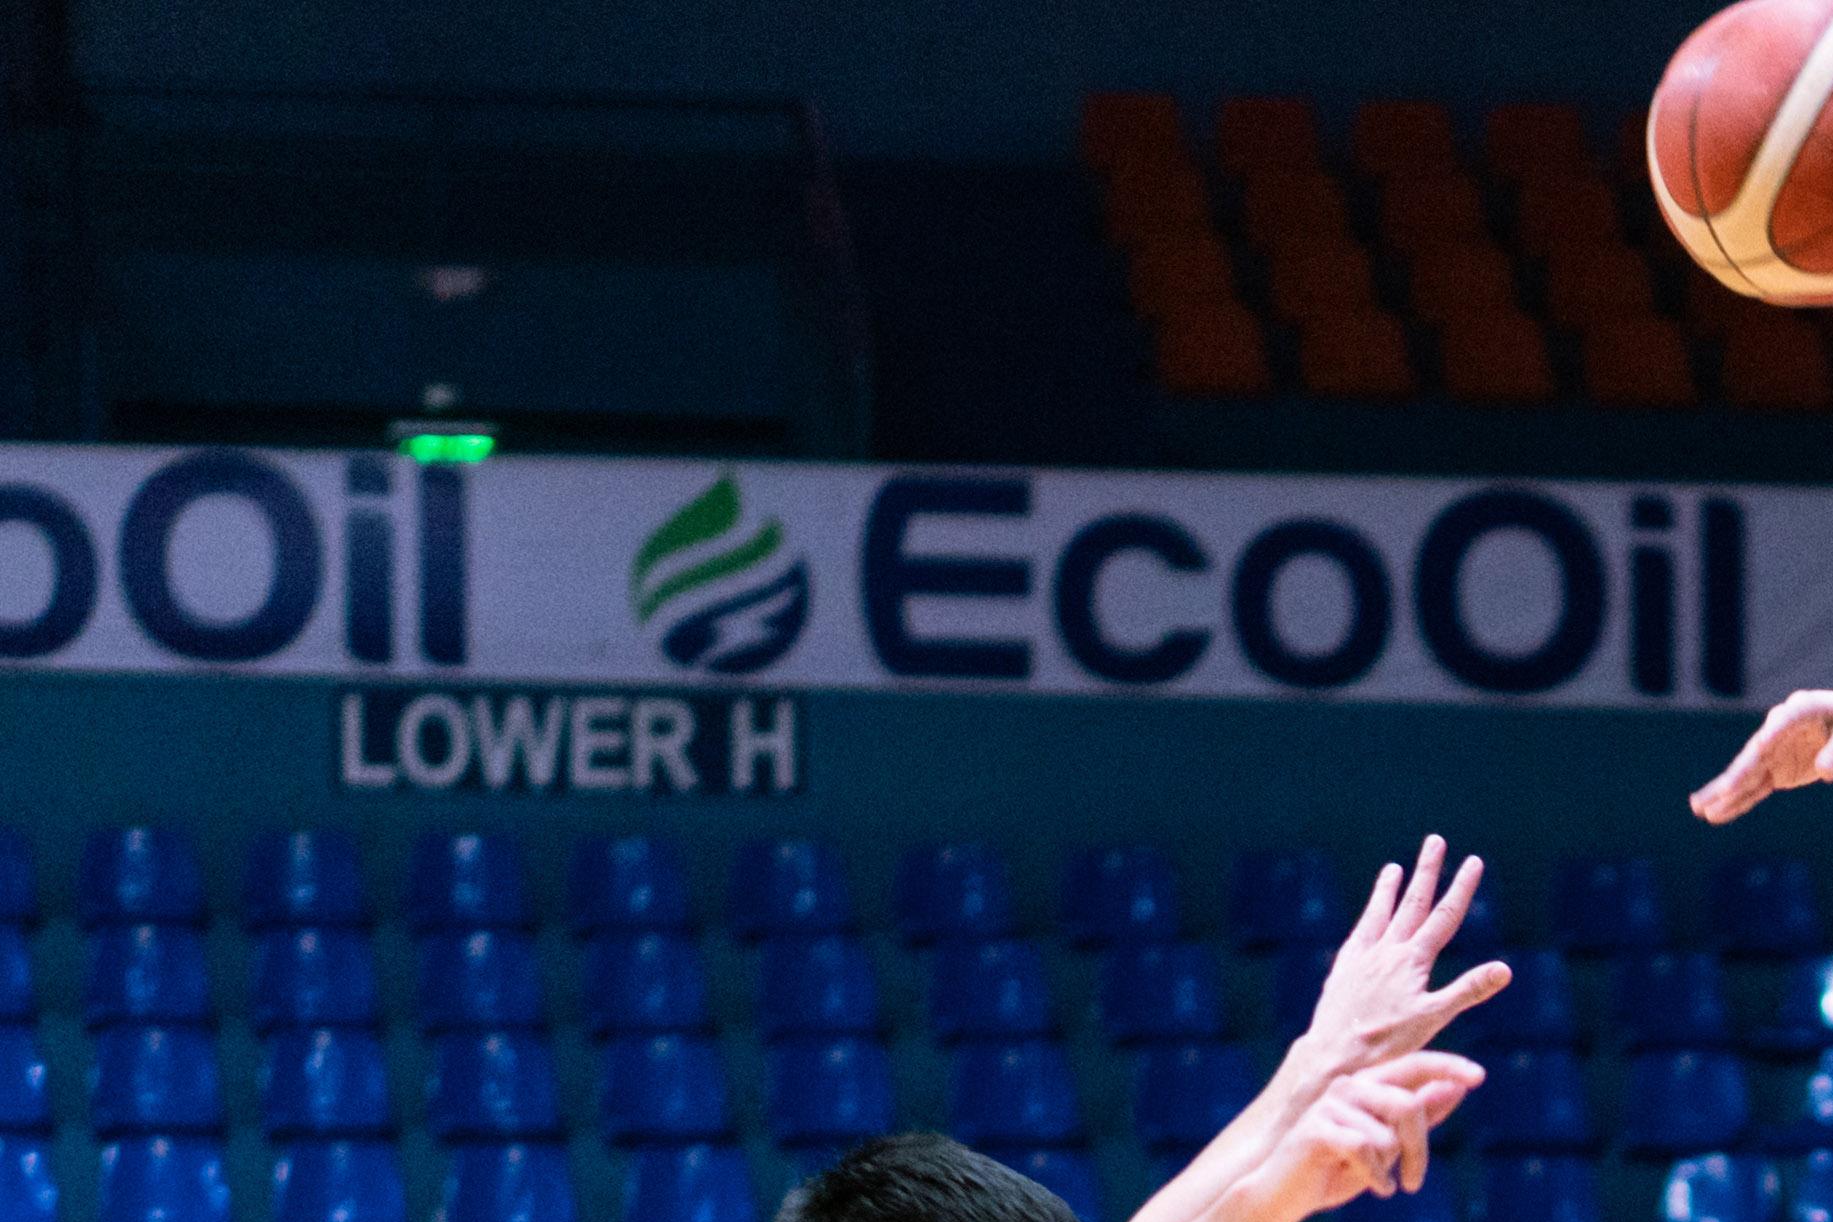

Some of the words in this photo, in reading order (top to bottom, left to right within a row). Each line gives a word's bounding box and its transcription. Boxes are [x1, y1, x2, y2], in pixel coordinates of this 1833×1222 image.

[860, 472, 1750, 699] EcoOil
[340, 694, 699, 791] LOWER
[729, 699, 797, 791] H
